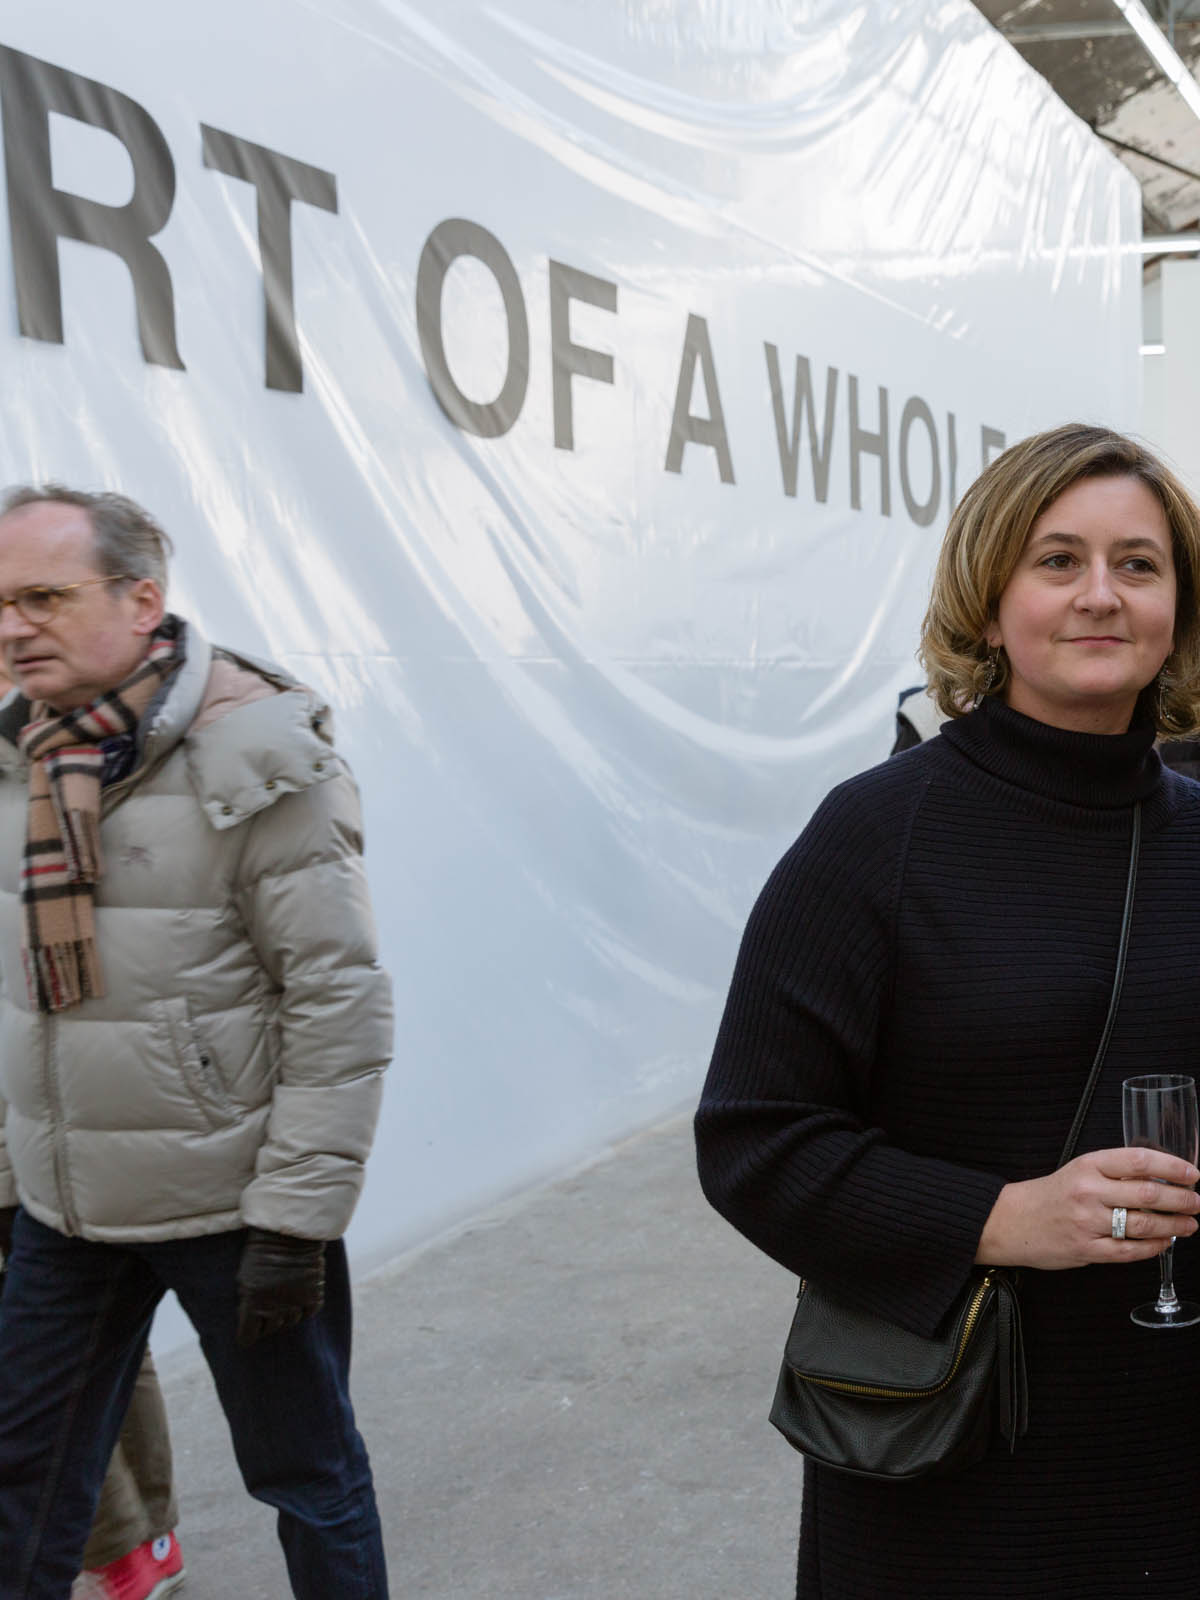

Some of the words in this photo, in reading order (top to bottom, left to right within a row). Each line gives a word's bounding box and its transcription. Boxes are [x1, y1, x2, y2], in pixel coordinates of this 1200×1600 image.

[0, 44, 339, 394] RT
[415, 217, 619, 452] OF
[664, 312, 736, 486] A
